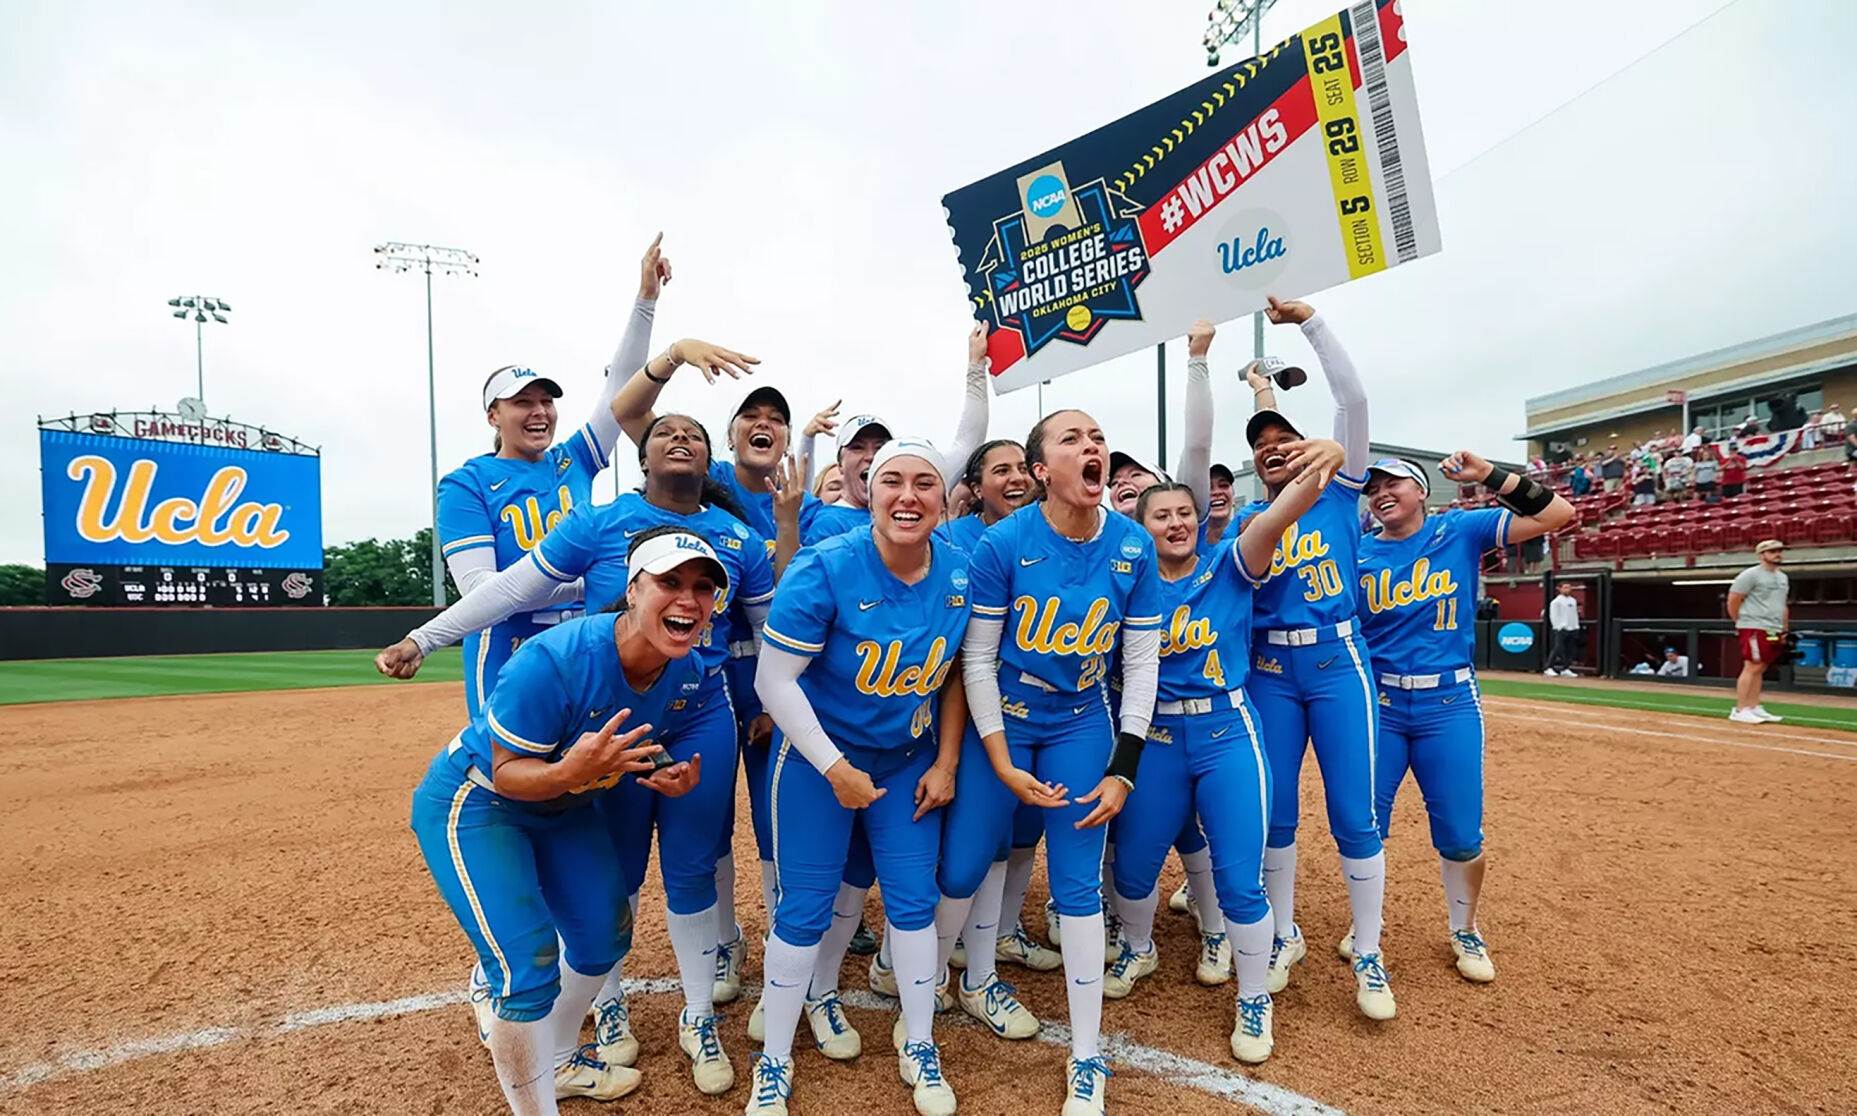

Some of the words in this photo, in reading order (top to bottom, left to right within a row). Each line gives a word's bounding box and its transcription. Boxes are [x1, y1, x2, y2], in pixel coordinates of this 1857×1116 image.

[1309, 32, 1344, 75] 25
[1324, 77, 1343, 106] SEAT
[1325, 117, 1359, 156] 29
[1160, 108, 1288, 234] #WCWS
[1339, 157, 1360, 184] ROW
[1032, 189, 1066, 212] NCAA
[1341, 195, 1370, 215] 5
[1020, 241, 1049, 261] 2025
[1051, 223, 1101, 249] WOMEN'S
[1022, 233, 1107, 284] COLLEGE
[1217, 227, 1287, 274] Ucla
[1352, 219, 1374, 265] SECTION
[999, 275, 1068, 316] WORLD
[1071, 247, 1142, 292] SERIES
[1032, 291, 1089, 318] OKLAHOMA
[1091, 281, 1117, 299] CITY
[134, 419, 247, 449] GAMECOCKS
[66, 455, 290, 548] Ucla
[501, 485, 573, 551] Ucl
[674, 535, 708, 556] Ucla
[1267, 520, 1329, 577] cla
[1298, 559, 1343, 602] 30
[1360, 557, 1458, 614] Ucla
[1013, 595, 1120, 656] Ucla
[1159, 604, 1219, 657] cla
[1433, 597, 1458, 631] 11
[1500, 636, 1533, 646] NCAA
[1203, 649, 1226, 687] 4
